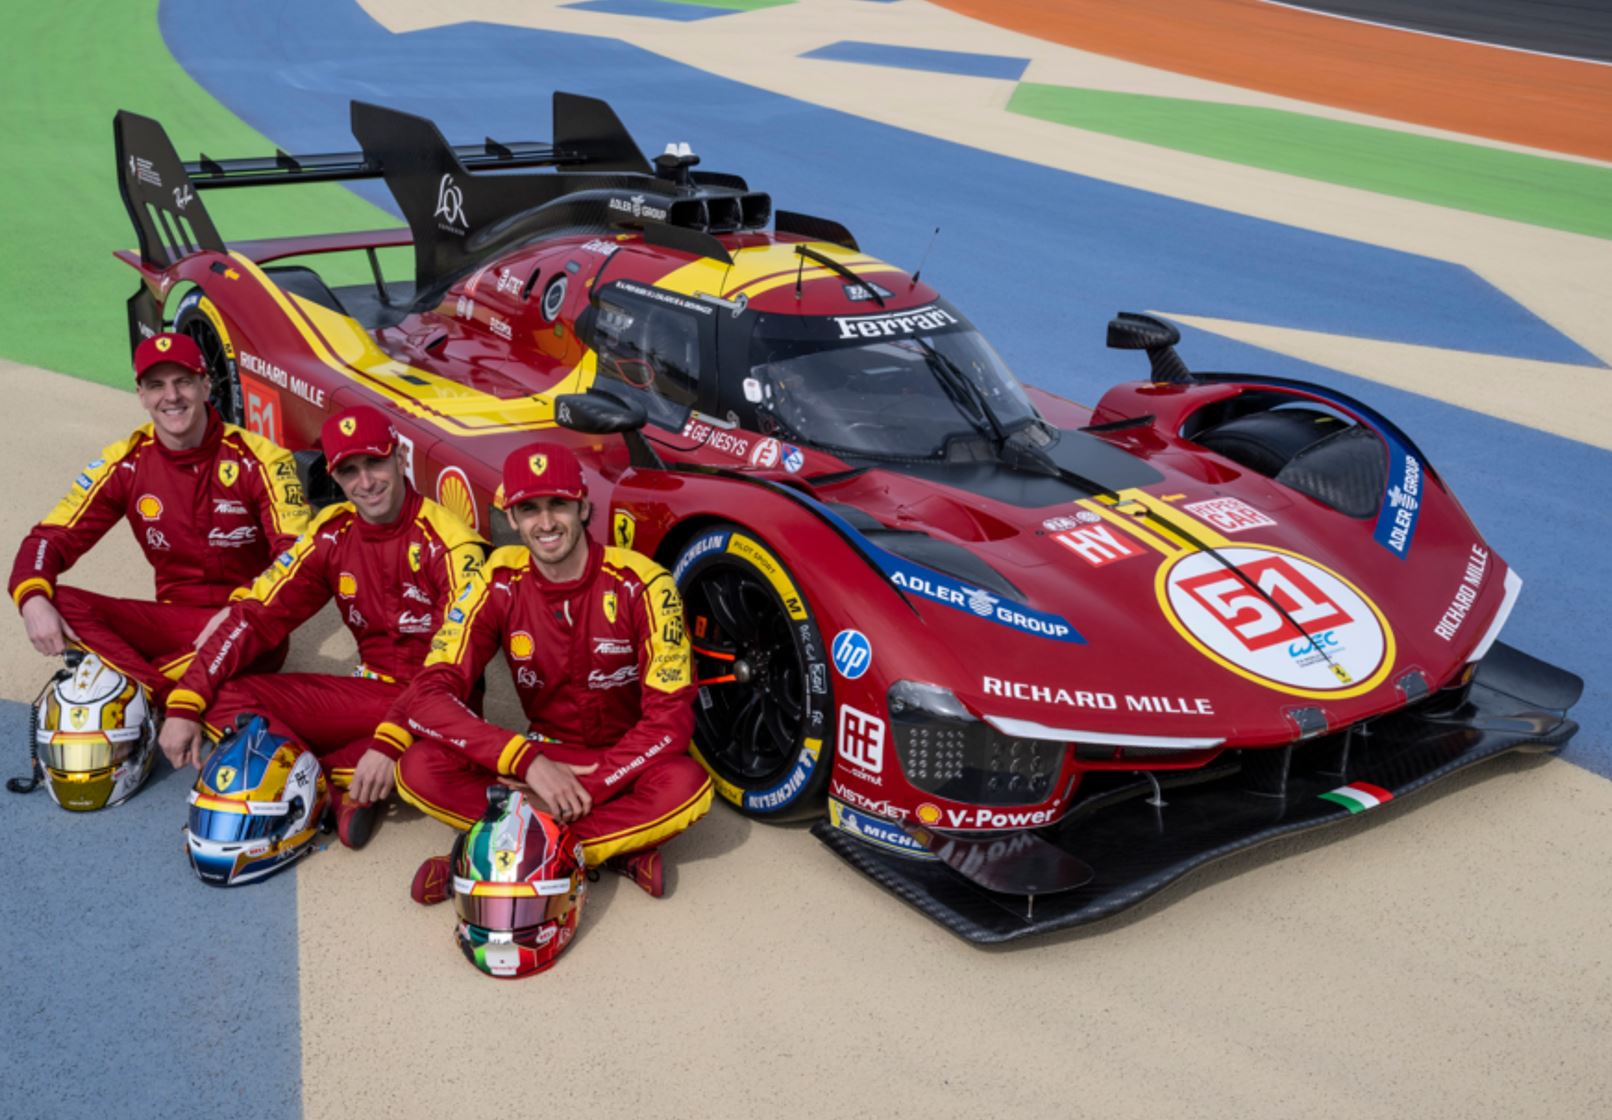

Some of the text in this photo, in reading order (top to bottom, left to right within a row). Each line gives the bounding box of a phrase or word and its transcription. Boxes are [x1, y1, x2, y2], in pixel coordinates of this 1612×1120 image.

[608, 197, 667, 220] ADLER GROUP
[834, 304, 958, 339] Ferrari
[240, 350, 325, 408] RICHARD MILLE
[1388, 455, 1420, 552] ADLER GROUP
[734, 540, 755, 554] PILOT
[1056, 525, 1131, 564] HY
[786, 597, 800, 613] M
[890, 571, 1069, 637] ADLER GROUP
[1192, 568, 1339, 639] 51
[1433, 543, 1489, 641] RICHARD MILLE
[834, 630, 869, 672] hp
[1288, 630, 1339, 657] WEC
[982, 675, 1215, 715] RICHARD MILLE
[748, 765, 806, 809] MICHELIN
[863, 823, 923, 850] MICH
[946, 807, 1057, 828] V-Power
